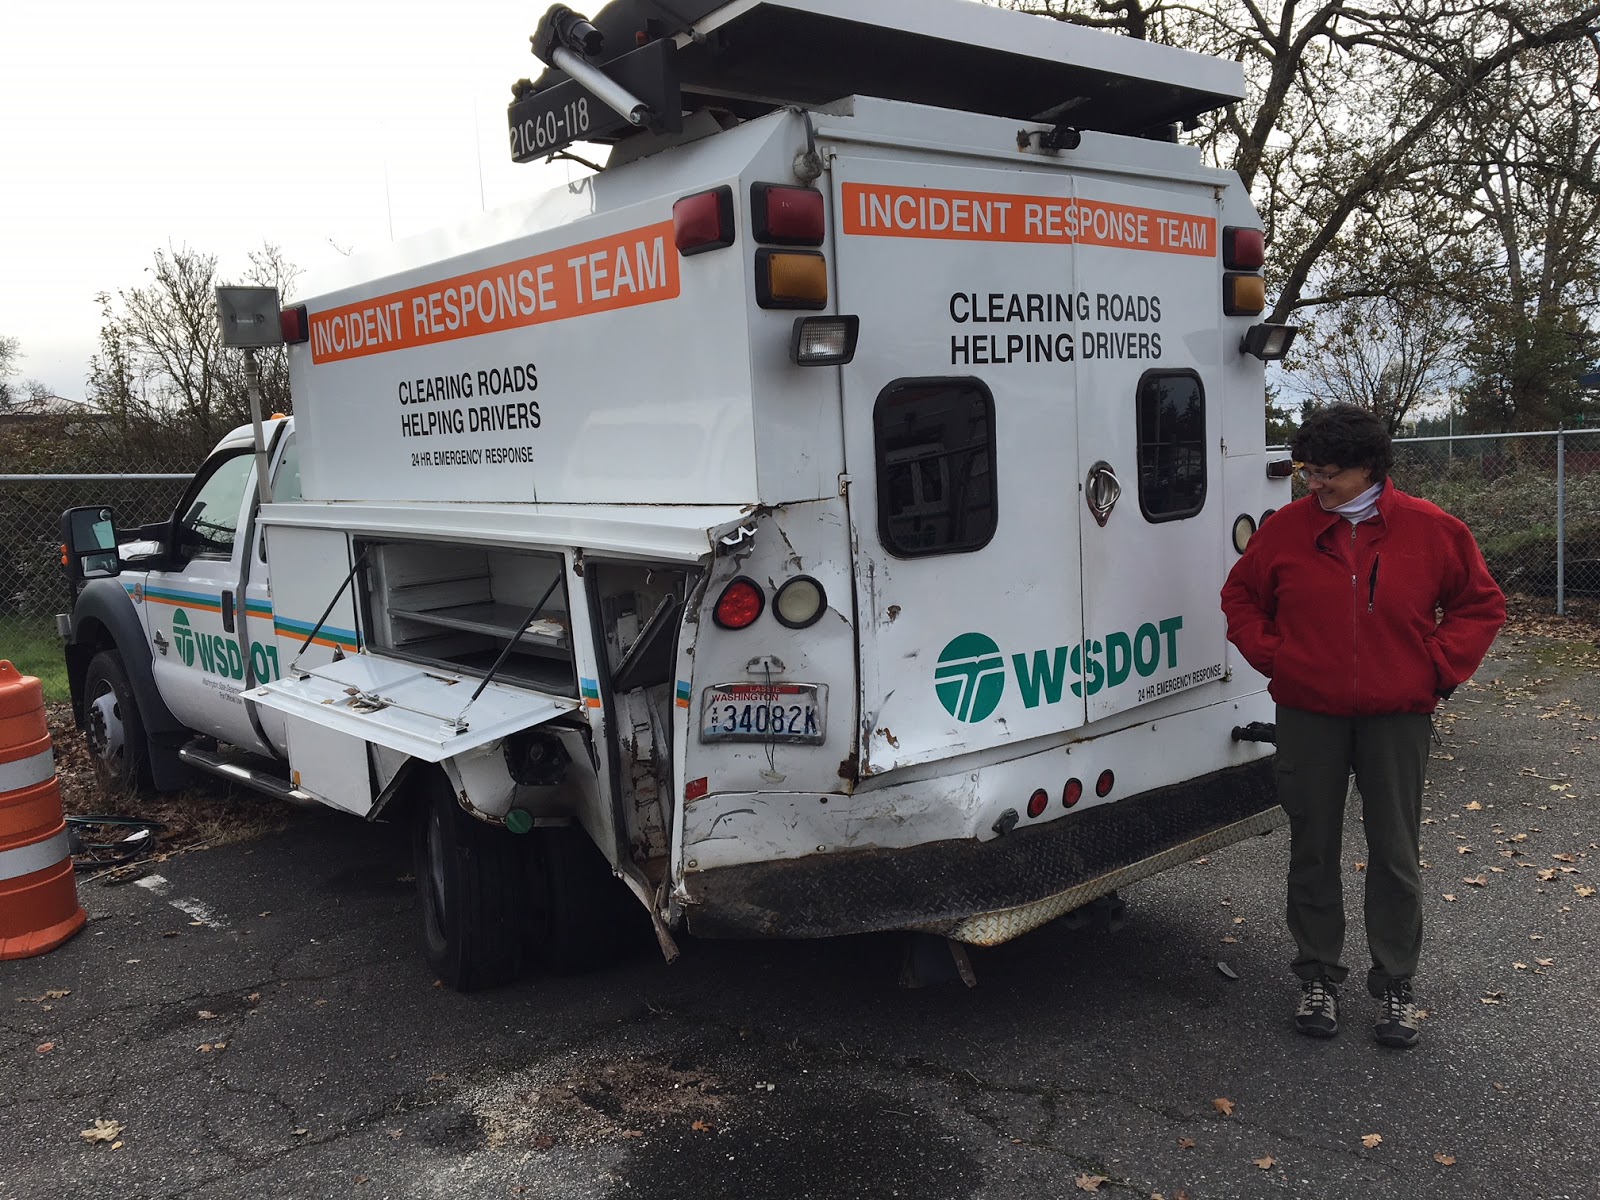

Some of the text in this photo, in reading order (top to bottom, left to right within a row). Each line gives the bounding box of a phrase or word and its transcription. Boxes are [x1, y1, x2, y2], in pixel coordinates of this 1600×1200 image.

[509, 97, 590, 158] 21C60-118
[859, 192, 1207, 250] INCIDENT RESPONSE TEAM
[312, 236, 667, 356] INCIDENT RESPONSE TEAM
[950, 292, 1161, 323] CLEARING ROADS
[951, 331, 1161, 364] HELPING DRIVERS
[398, 363, 538, 405] CLEARING ROADS
[401, 401, 541, 437] HELPING DRIVERS
[411, 446, 534, 466] 24 HR. EMERGENCY RESPONSE
[195, 631, 280, 684] WSDOT
[1012, 616, 1183, 709] WSDOT
[712, 693, 779, 702] WASHINGTON
[1137, 663, 1222, 702] 24 HR. EMERGENCY RESPONSE
[723, 704, 818, 735] 34082K
